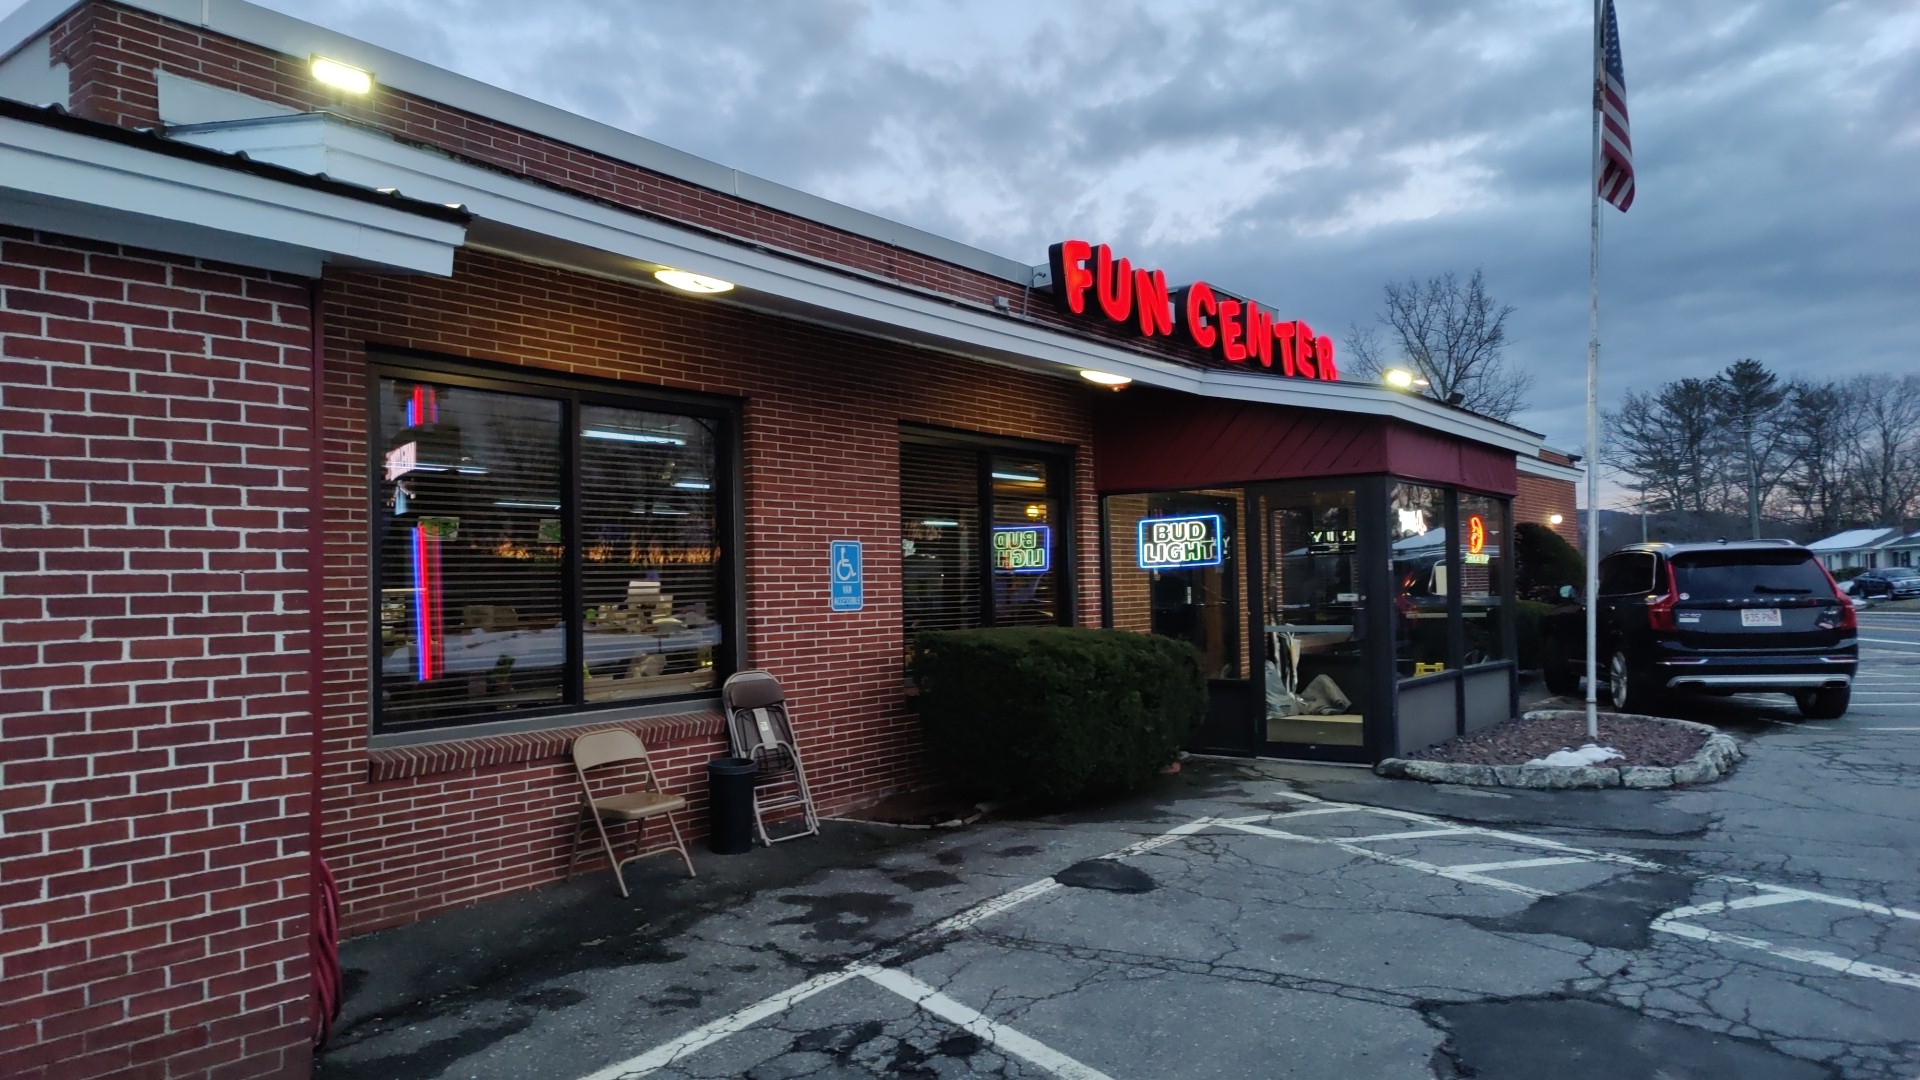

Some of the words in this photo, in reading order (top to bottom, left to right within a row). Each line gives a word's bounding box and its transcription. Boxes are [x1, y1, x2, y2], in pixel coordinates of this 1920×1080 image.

[1061, 239, 1172, 337] FUN
[1186, 280, 1339, 382] CENTER
[1153, 521, 1206, 543] BUD
[1143, 541, 1217, 563] LIGHT
